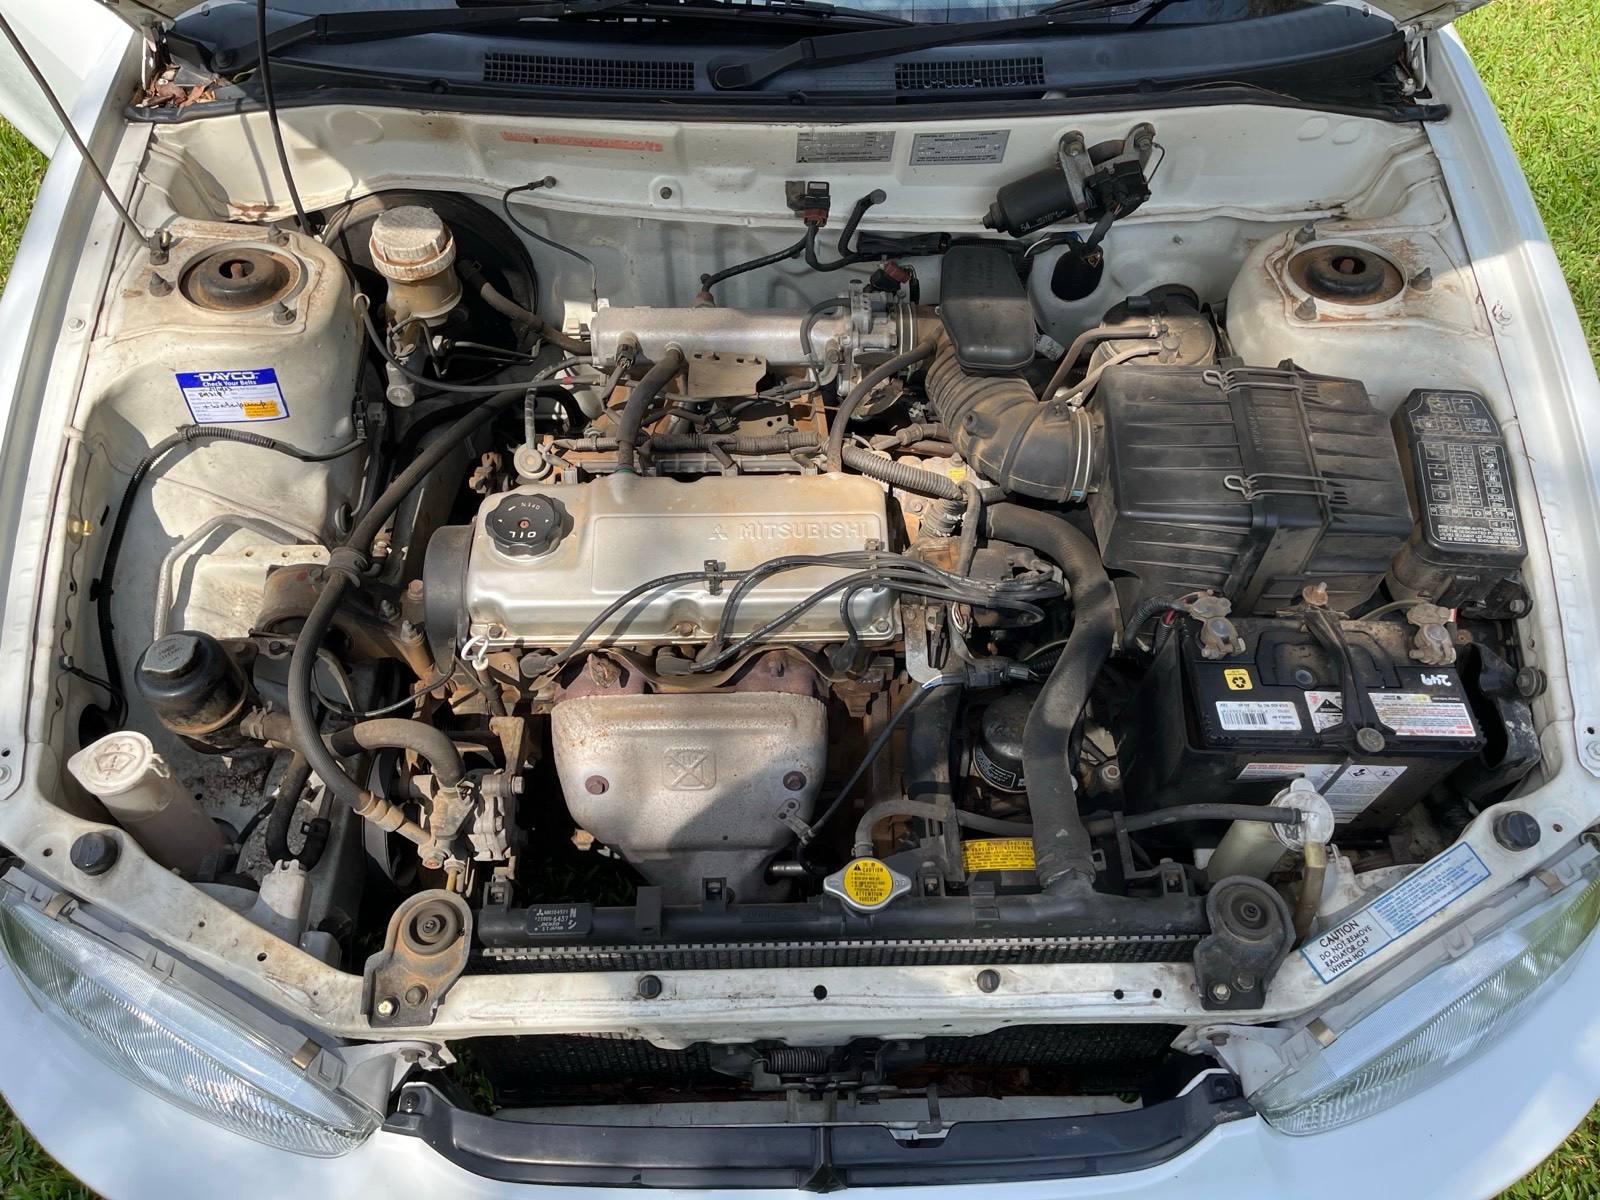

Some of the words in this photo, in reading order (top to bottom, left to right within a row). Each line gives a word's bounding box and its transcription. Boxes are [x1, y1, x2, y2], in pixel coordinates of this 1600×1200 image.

[198, 372, 257, 382] DAYCO
[508, 530, 536, 538] OIL
[739, 522, 868, 540] MITSUBISHI
[1320, 919, 1359, 948] CAUTION
[1320, 951, 1331, 961] DO
[1332, 940, 1347, 954] NOT
[1347, 926, 1372, 943] REMOVE
[1325, 944, 1357, 968] RADIATOR
[1356, 936, 1370, 948] CAP
[1330, 959, 1352, 974] WHEN
[1353, 948, 1367, 961] HOT
